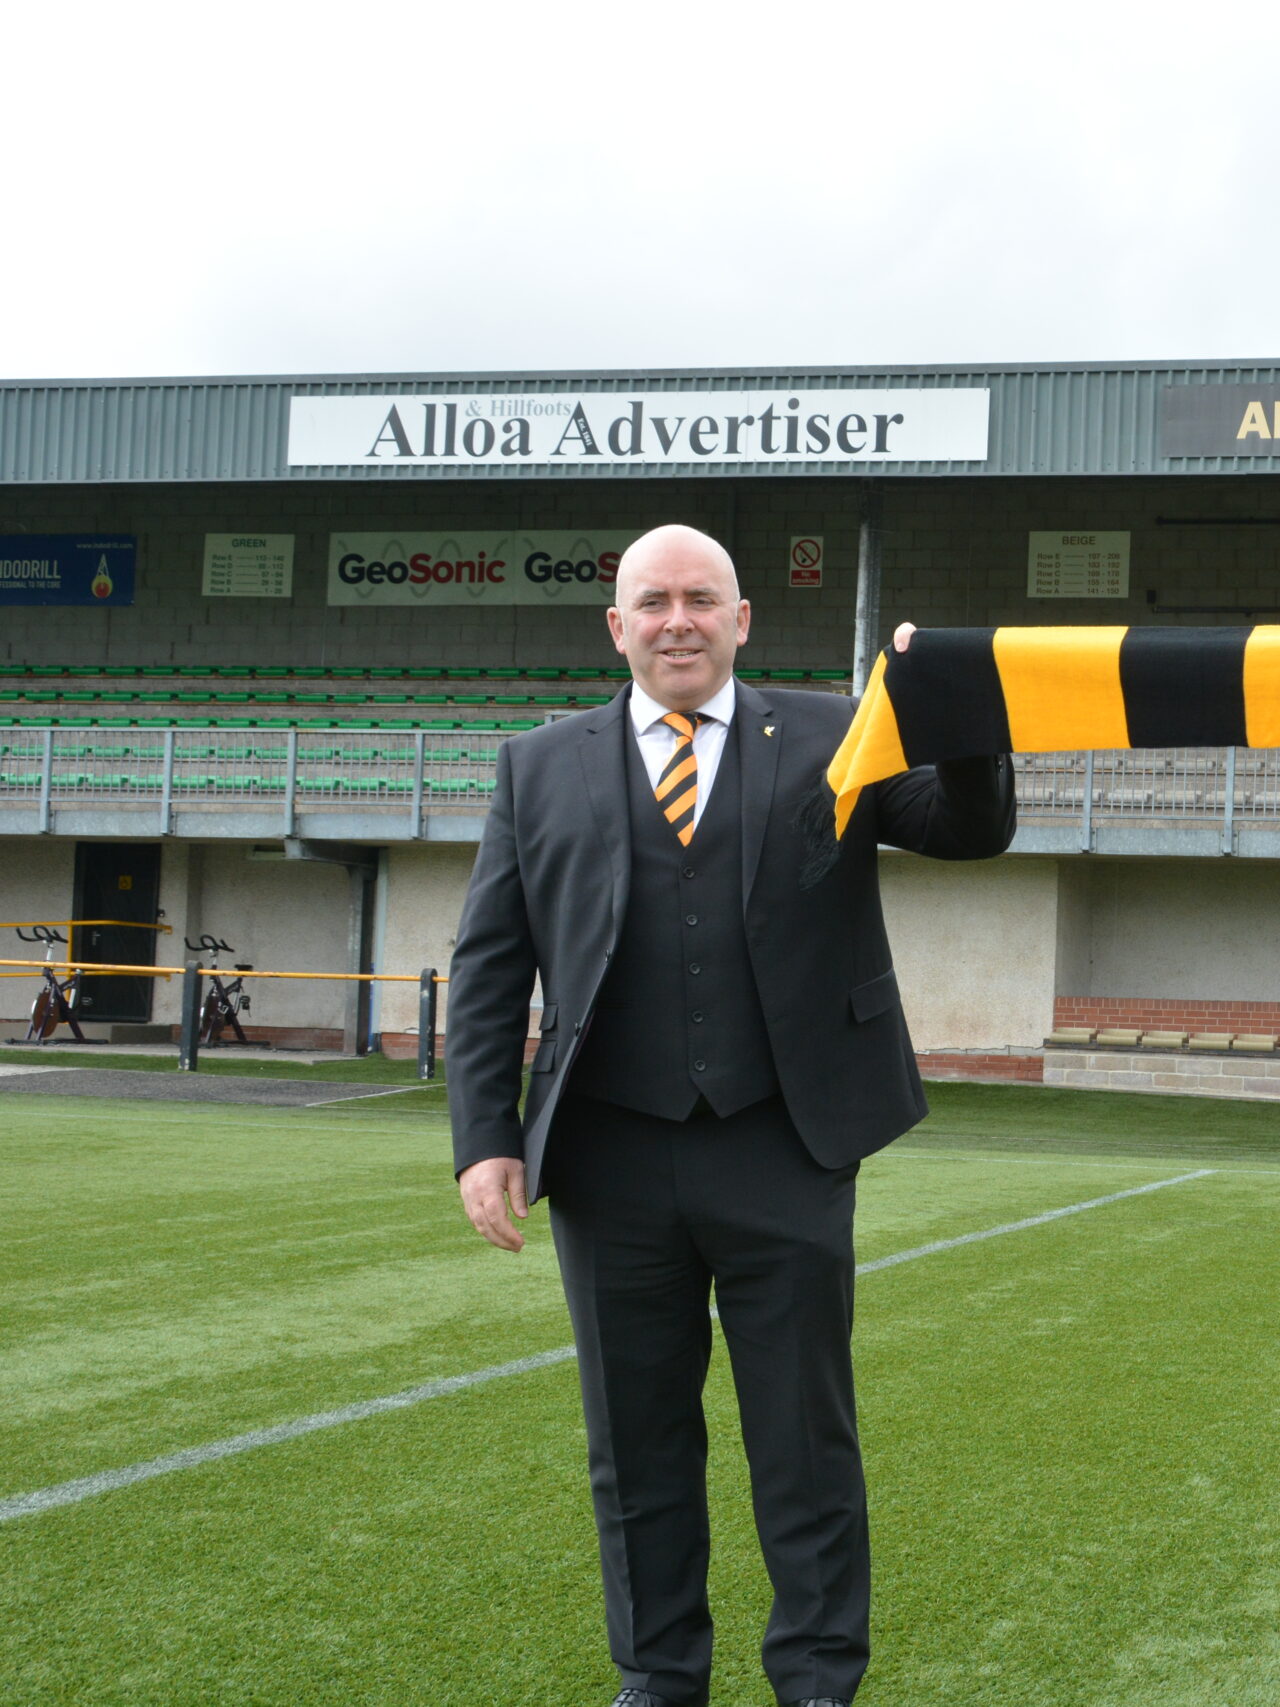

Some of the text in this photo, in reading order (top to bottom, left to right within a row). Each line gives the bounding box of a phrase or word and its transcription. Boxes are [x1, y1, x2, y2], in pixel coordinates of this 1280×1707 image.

[465, 399, 572, 417] & Hillfoots
[364, 397, 904, 457] Alloa Advertiser
[232, 538, 266, 548] GREEN
[1062, 536, 1096, 545] BEIGE
[338, 551, 506, 585] GeoSonic
[524, 552, 621, 583] GeoS
